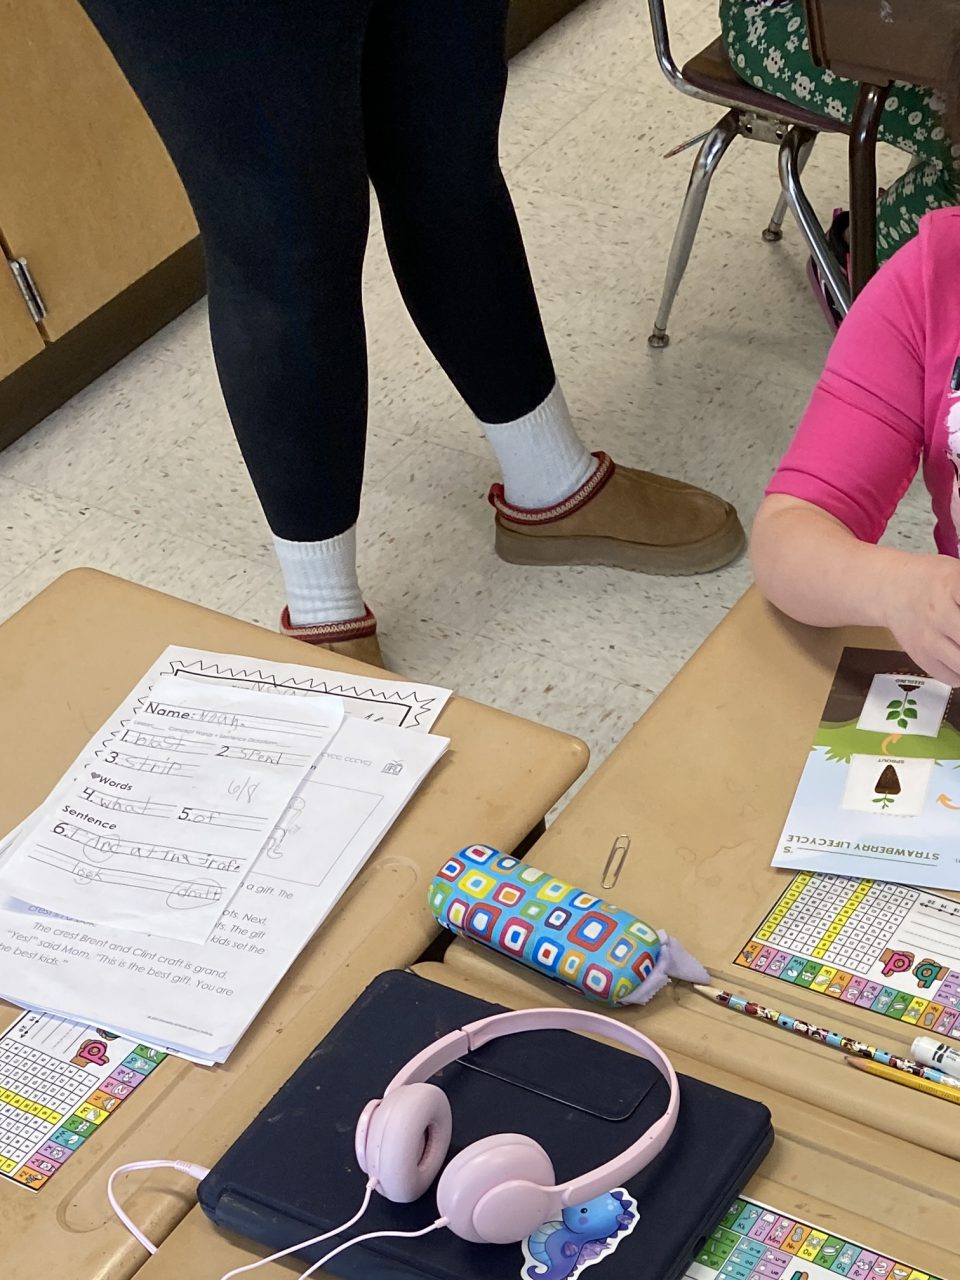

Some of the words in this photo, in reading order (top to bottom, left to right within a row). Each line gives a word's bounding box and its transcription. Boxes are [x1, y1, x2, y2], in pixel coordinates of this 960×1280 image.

[143, 702, 196, 720] Name:
[104, 751, 119, 765] 3.
[215, 745, 231, 757] 2.
[97, 774, 133, 792] Words
[82, 786, 96, 803] 4.
[62, 805, 117, 831] Sentence
[178, 807, 193, 822] 5.
[53, 822, 68, 838] 6.
[786, 834, 851, 849] LIFECYCLE
[853, 844, 940, 861] STRAWBERRY
[230, 924, 248, 935] The
[210, 935, 231, 946] kids
[13, 947, 38, 960] best
[32, 922, 52, 933] The
[53, 928, 79, 940] crest
[80, 934, 108, 948] Brent
[109, 942, 132, 954] and
[132, 947, 157, 961] Clint
[158, 955, 184, 968] craft
[192, 964, 228, 980] grand.
[37, 940, 62, 951] said
[128, 962, 145, 974] the
[147, 967, 172, 980] best
[196, 980, 216, 992] You
[215, 987, 234, 997] are
